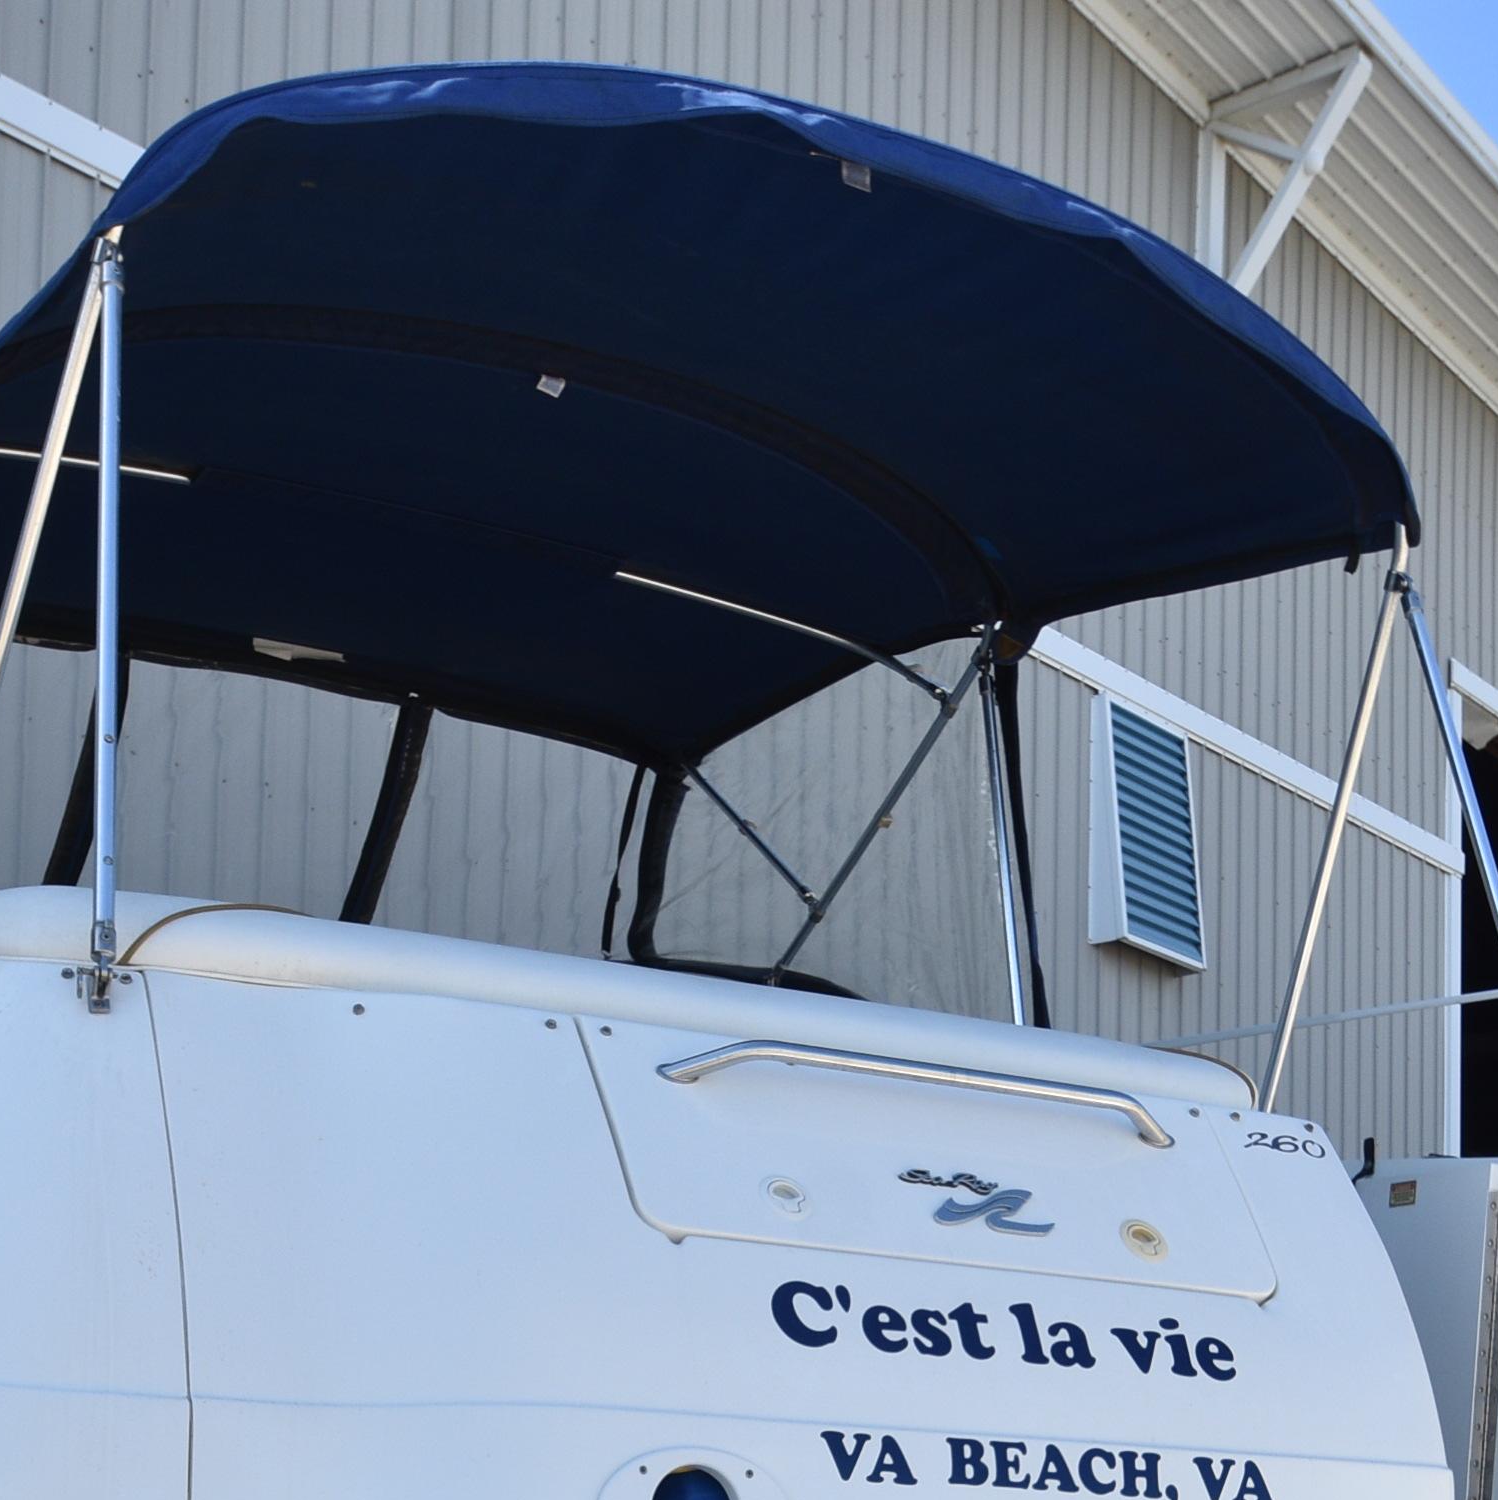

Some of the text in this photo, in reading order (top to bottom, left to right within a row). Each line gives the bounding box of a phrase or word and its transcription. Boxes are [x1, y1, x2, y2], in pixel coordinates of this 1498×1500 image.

[1243, 1131, 1326, 1159] 260
[770, 1280, 1238, 1382] C'est la vie
[819, 1430, 919, 1486] VA
